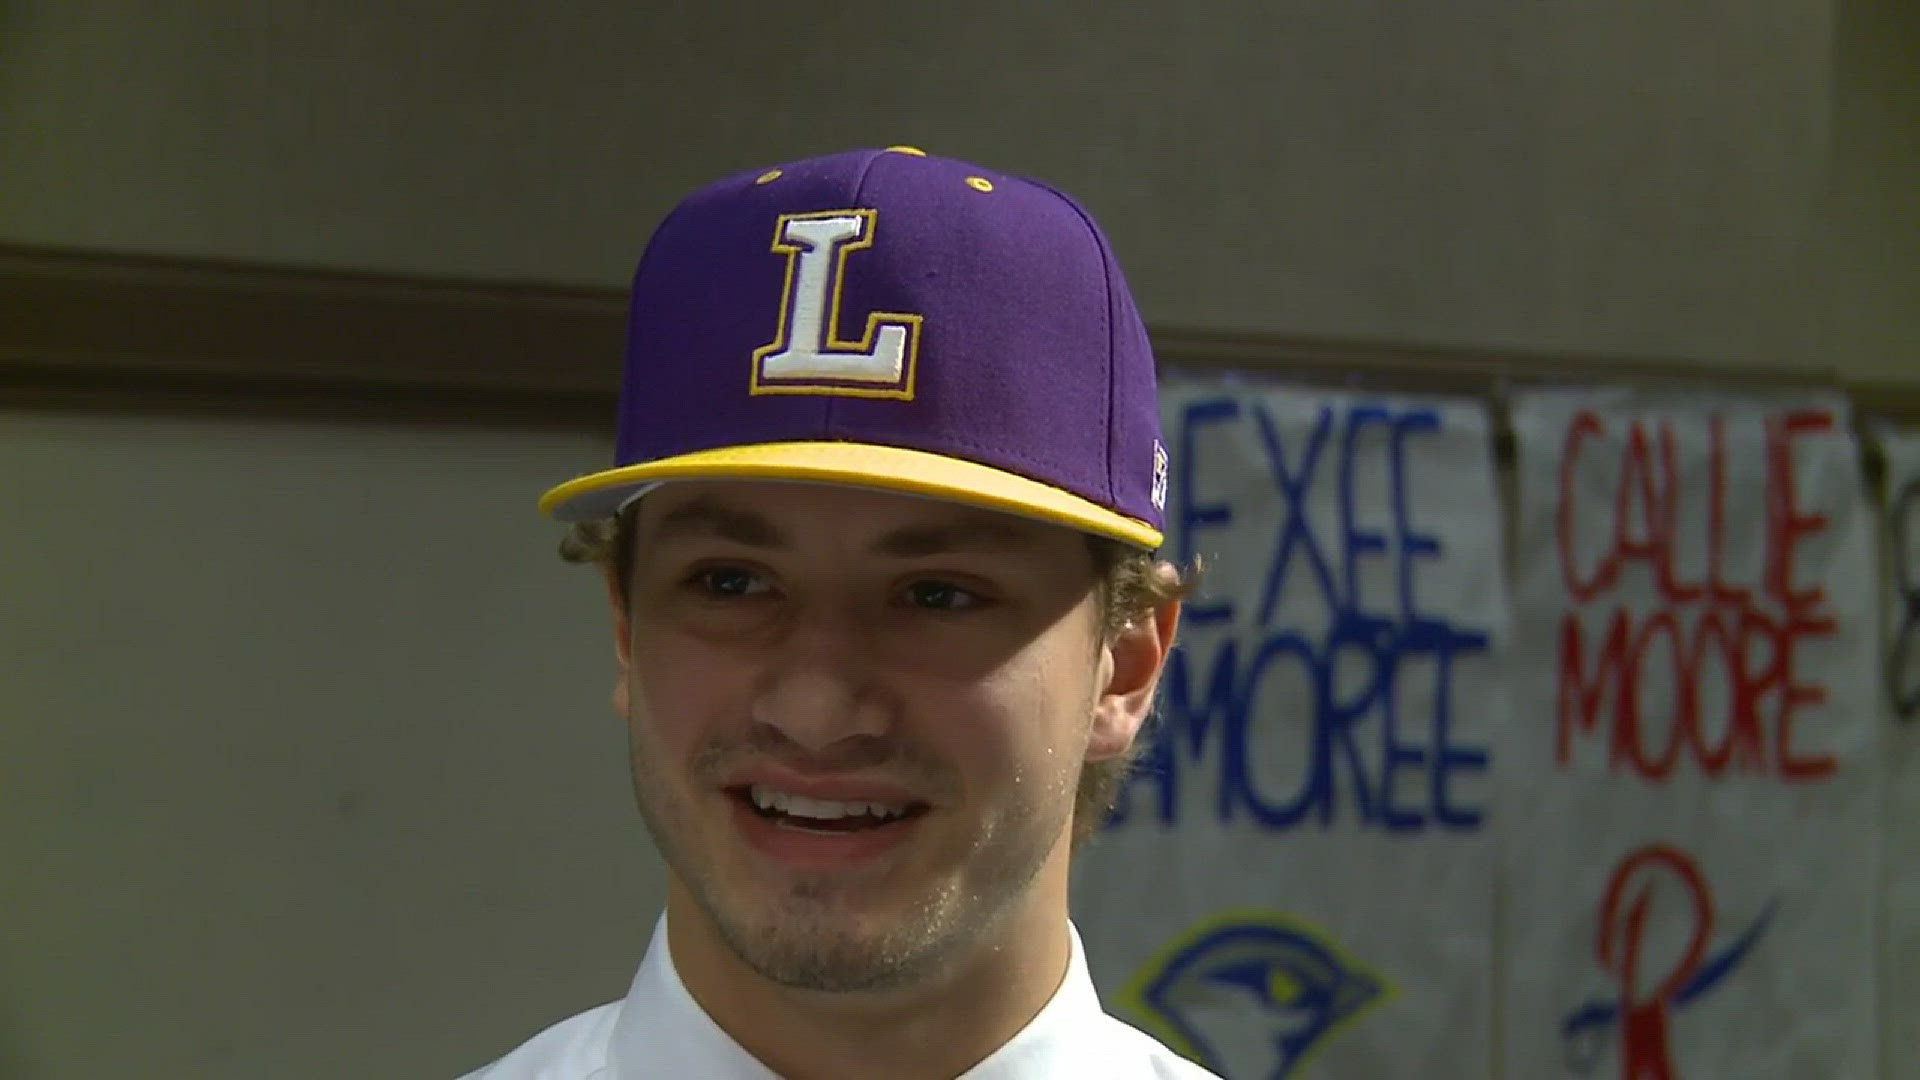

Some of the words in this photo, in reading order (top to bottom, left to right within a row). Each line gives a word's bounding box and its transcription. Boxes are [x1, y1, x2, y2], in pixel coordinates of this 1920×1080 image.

[750, 208, 923, 401] L
[1556, 411, 1835, 610] CALLIE
[1554, 606, 1840, 786] MOORE
